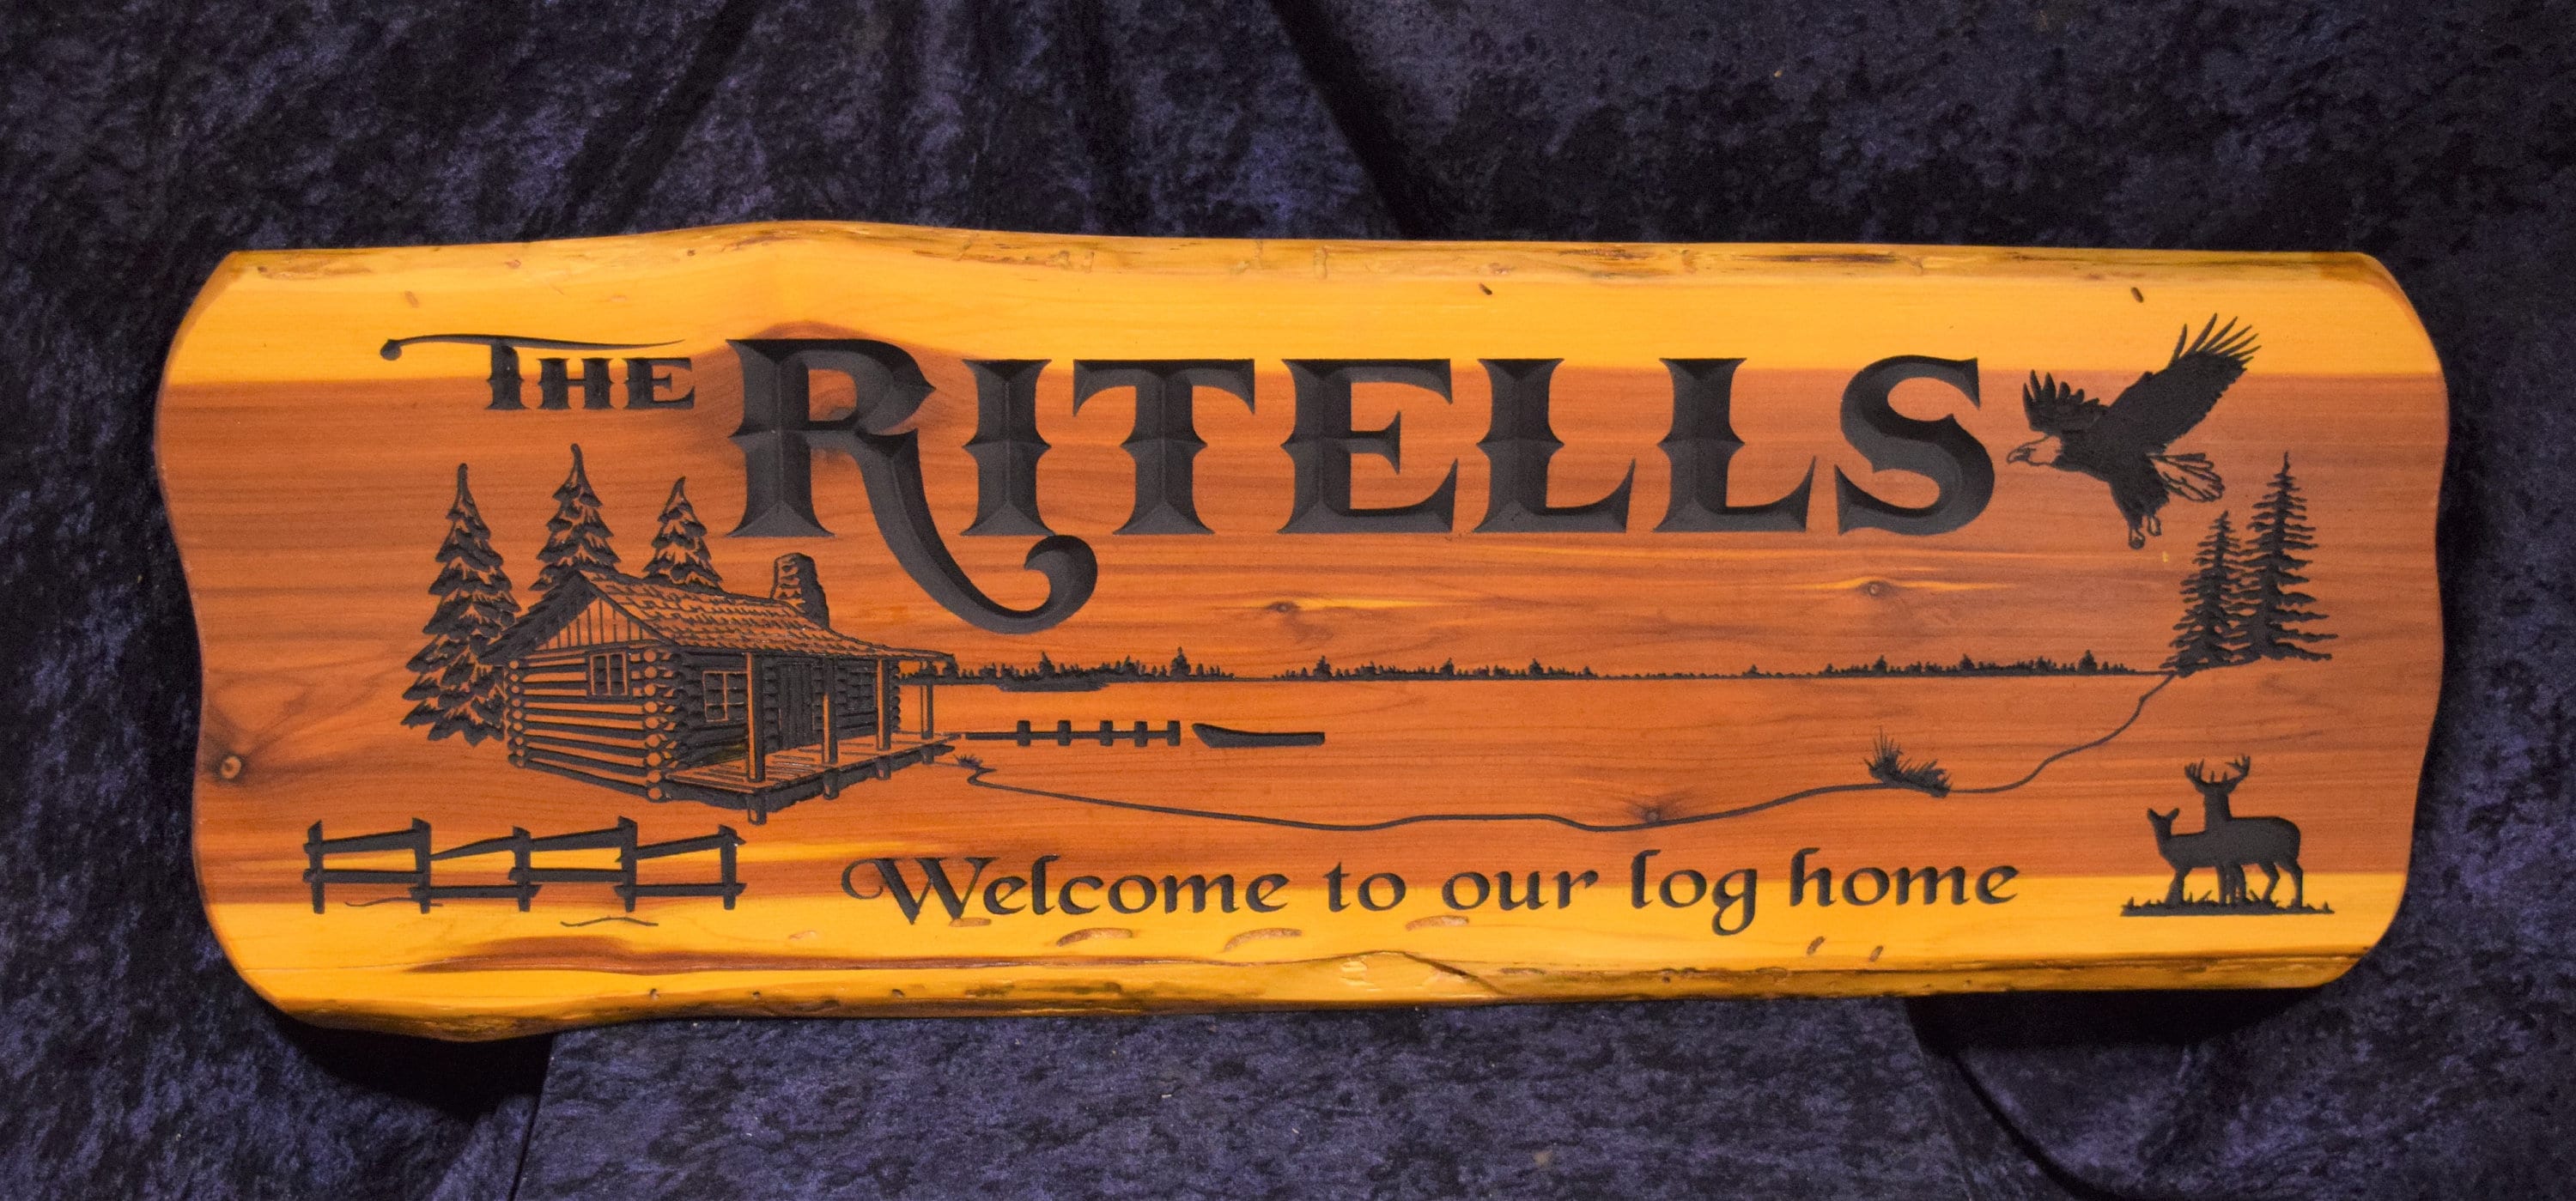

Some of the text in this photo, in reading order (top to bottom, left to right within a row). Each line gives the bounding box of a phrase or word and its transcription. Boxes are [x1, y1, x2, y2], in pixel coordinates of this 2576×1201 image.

[841, 846, 2020, 937] Welcome to our log home
